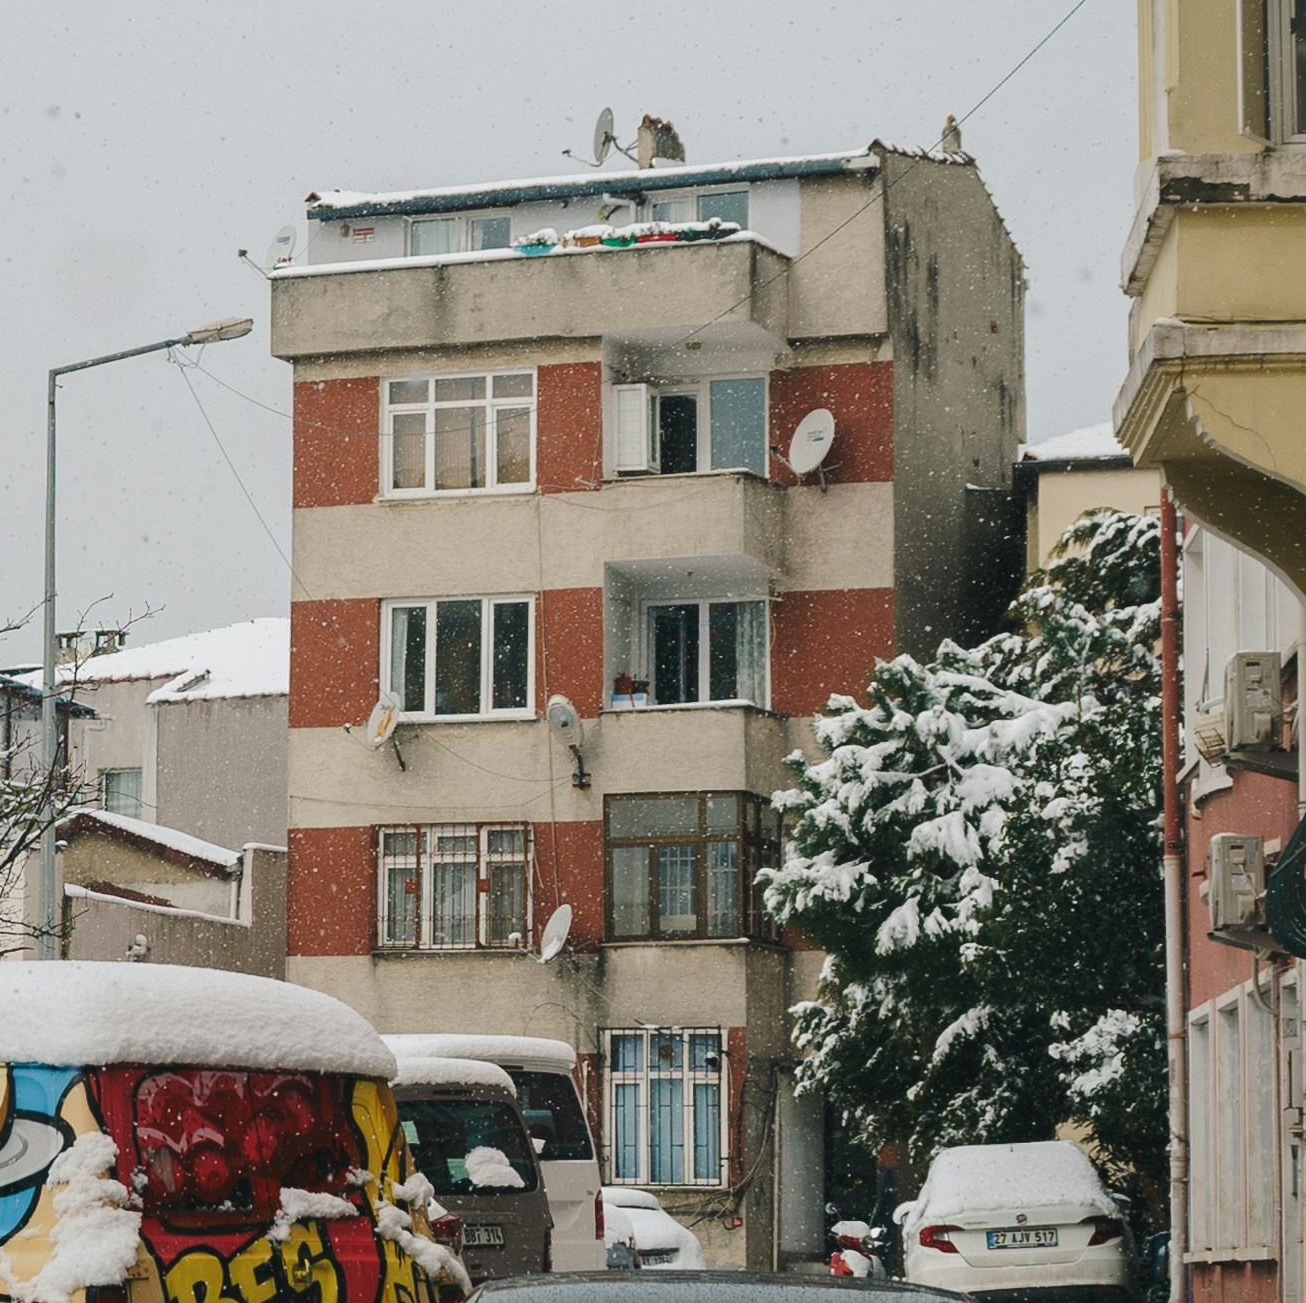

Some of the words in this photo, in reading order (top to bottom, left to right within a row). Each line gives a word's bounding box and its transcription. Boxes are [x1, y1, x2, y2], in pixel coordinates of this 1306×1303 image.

[484, 1227, 502, 1243] 314
[994, 1233, 1007, 1245] 27
[1012, 1232, 1031, 1244] AJV
[1034, 1231, 1055, 1242] 517
